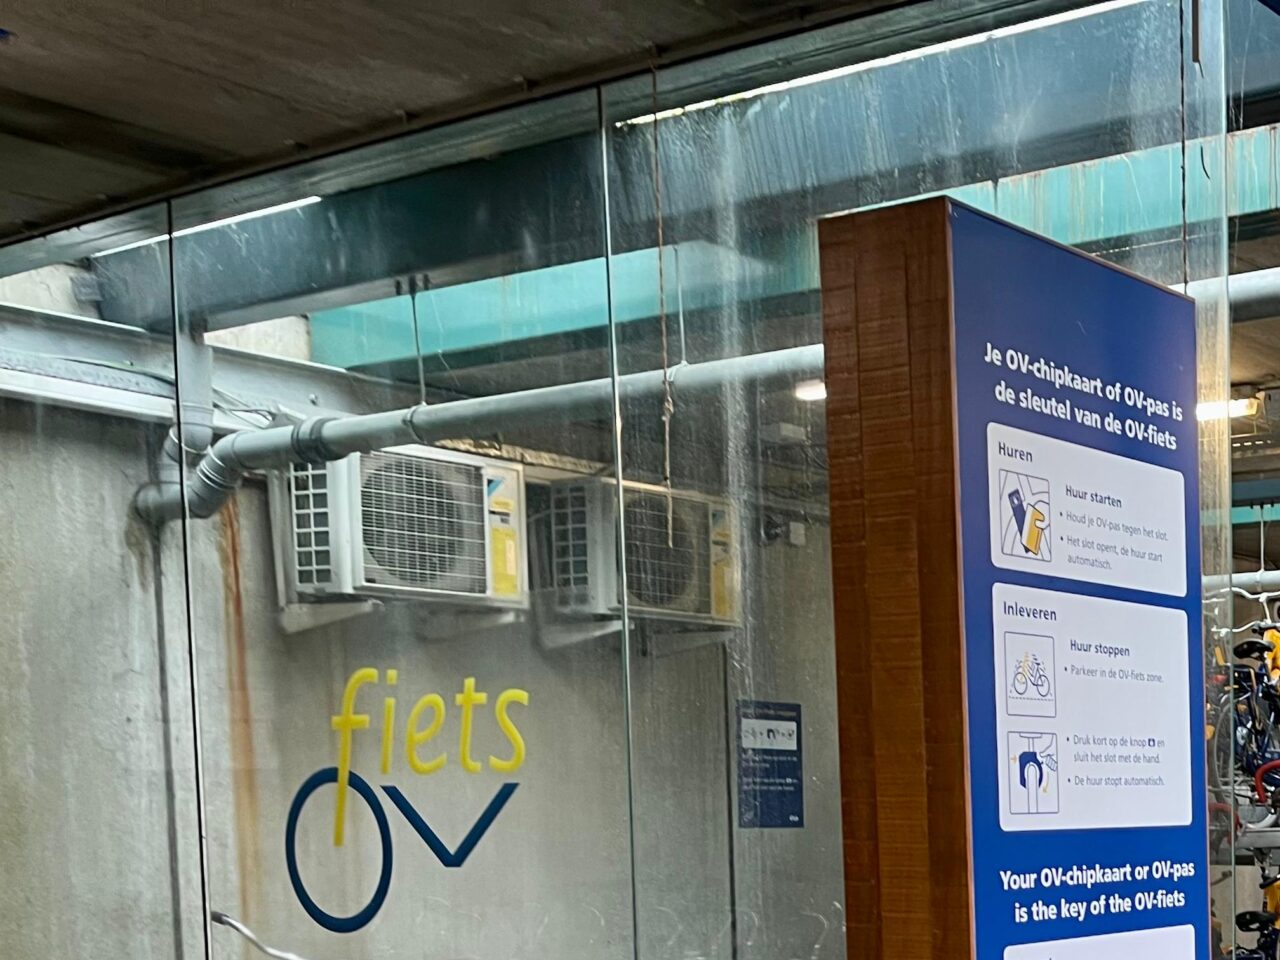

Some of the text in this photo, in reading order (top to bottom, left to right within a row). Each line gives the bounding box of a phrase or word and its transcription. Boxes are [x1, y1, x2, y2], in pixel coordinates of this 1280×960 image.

[984, 342, 1183, 422] Je OV-chipkaart of OV-pas is
[995, 381, 1177, 450] de sleutel van de OV-fiets
[998, 442, 1032, 462] Huren
[1066, 485, 1121, 508] Huur starten
[1066, 511, 1168, 541] Houd je OV-pas tegen het slot.
[1067, 535, 1162, 562] Het slot opent, de huur start
[1068, 554, 1111, 570] automatisch.
[1003, 601, 1057, 621] Inleveren
[1070, 639, 1130, 657] Huur stoppen
[1071, 665, 1163, 683] Parkeer in de OV-fiets zone.
[1073, 735, 1165, 750] Druk kort op de knop en
[331, 667, 529, 847] fiets
[1074, 752, 1160, 764] sluit het slot met de hand.
[1075, 775, 1165, 788] De huur stopt automatisch.
[286, 767, 520, 933] OV
[1000, 861, 1195, 890] Your OV-chipkaart or OV-pas
[1015, 890, 1185, 923] is the key of the OV-fiets
